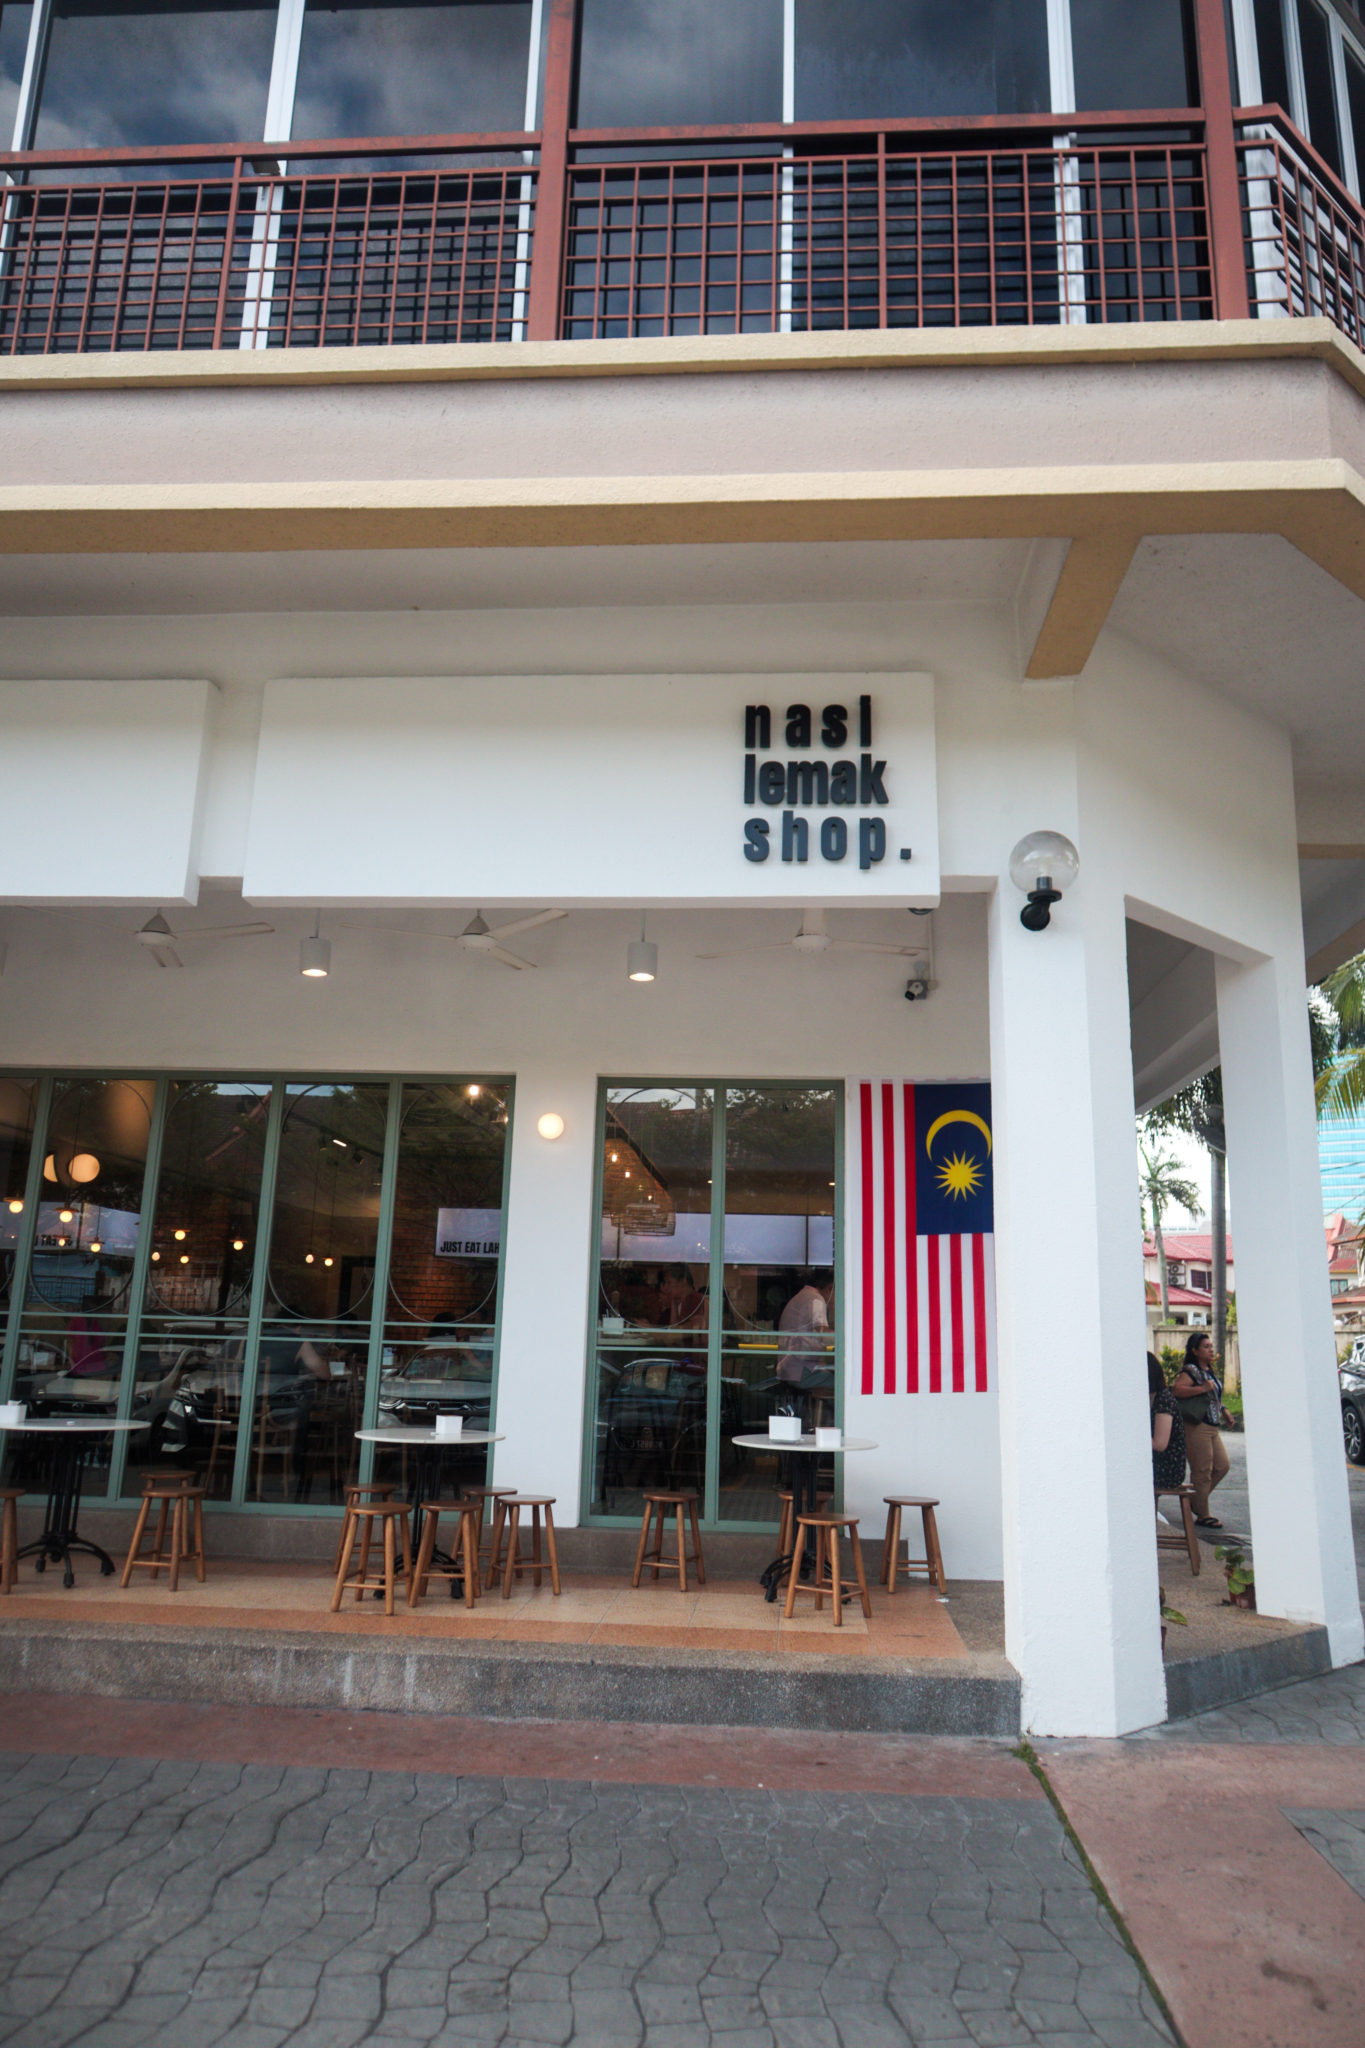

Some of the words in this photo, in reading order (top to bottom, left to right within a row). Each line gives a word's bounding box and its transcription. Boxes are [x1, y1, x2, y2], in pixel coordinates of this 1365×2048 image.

[745, 695, 871, 748] nasi
[744, 753, 889, 804] lemak
[744, 810, 911, 869] shop.
[440, 1241, 462, 1253] JUST
[465, 1241, 481, 1253] EAT
